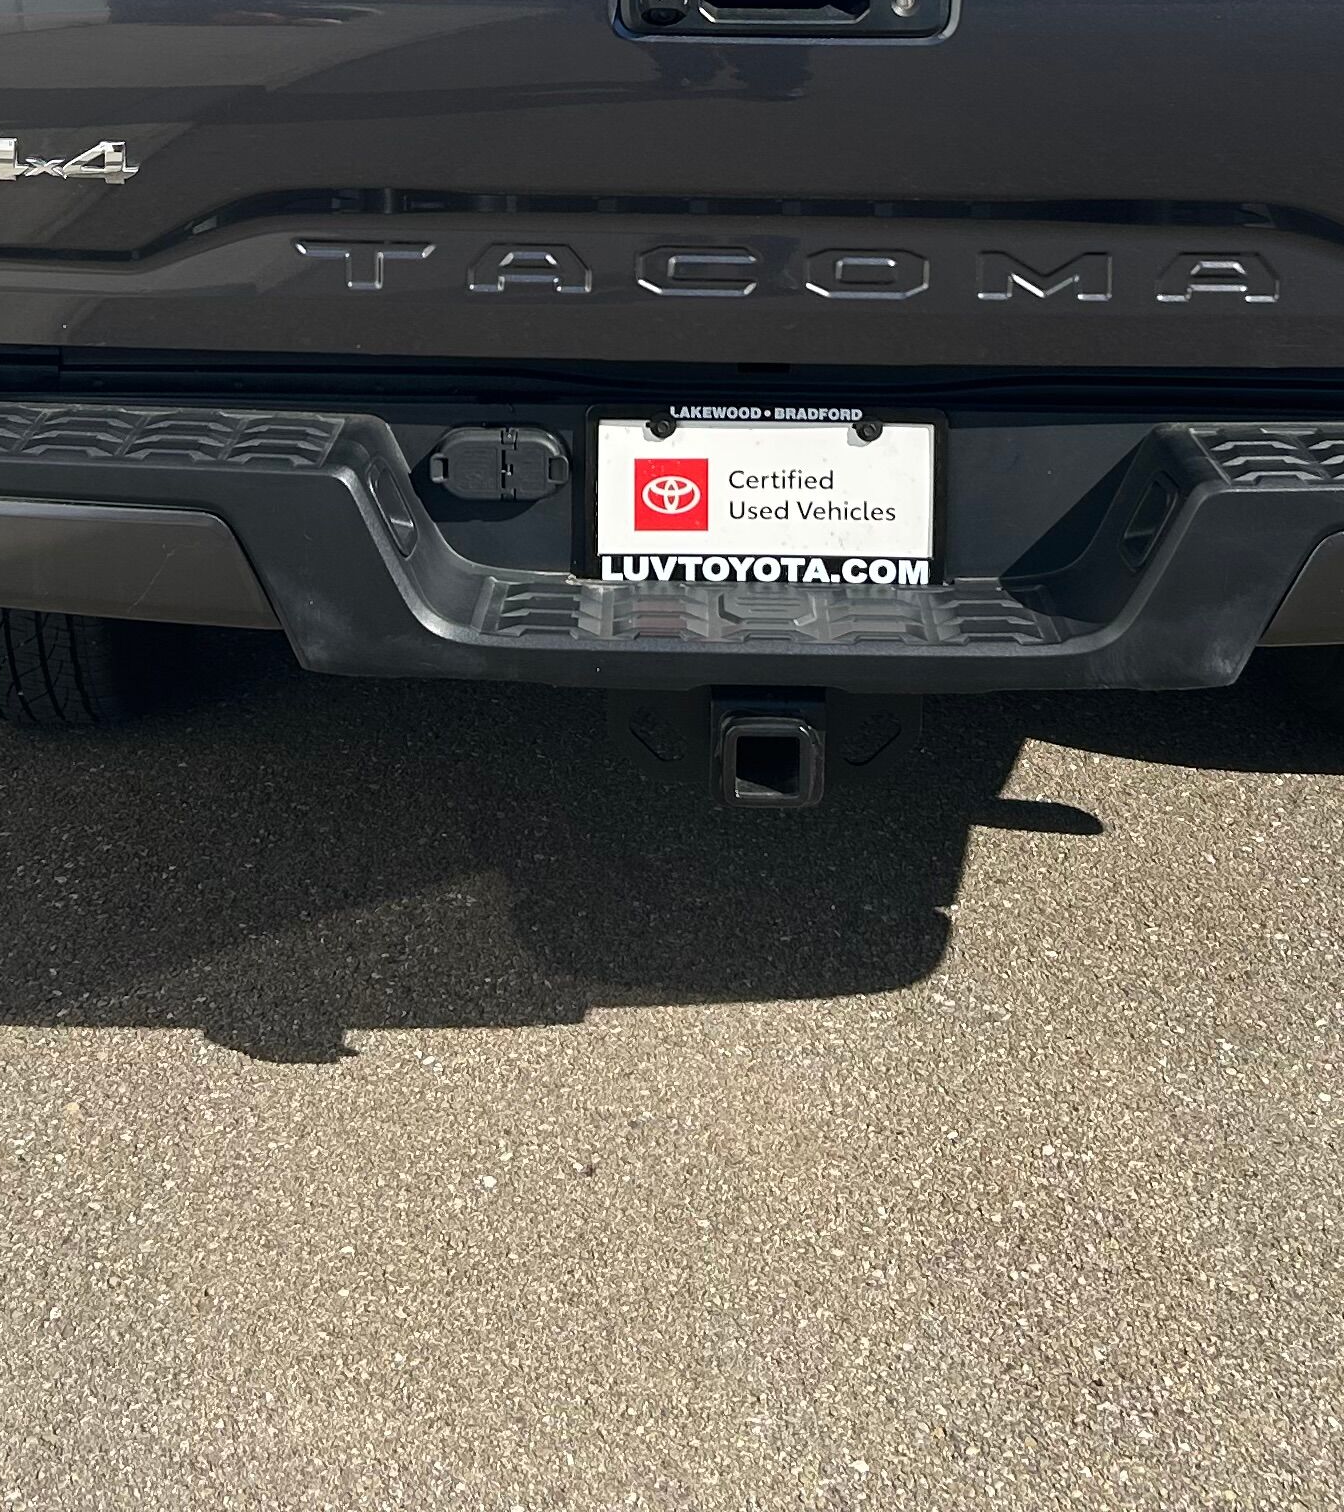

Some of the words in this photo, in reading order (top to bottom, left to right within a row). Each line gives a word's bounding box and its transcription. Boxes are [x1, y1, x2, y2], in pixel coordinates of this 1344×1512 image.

[294, 238, 1281, 304] TACOMA
[669, 406, 762, 420] LAKEWOOD
[774, 407, 863, 421] BRADFORD
[728, 469, 834, 490] Certified
[728, 500, 789, 520] Used
[797, 501, 896, 521] Vehicles
[600, 555, 930, 586] LUVTOYOTA.COM
